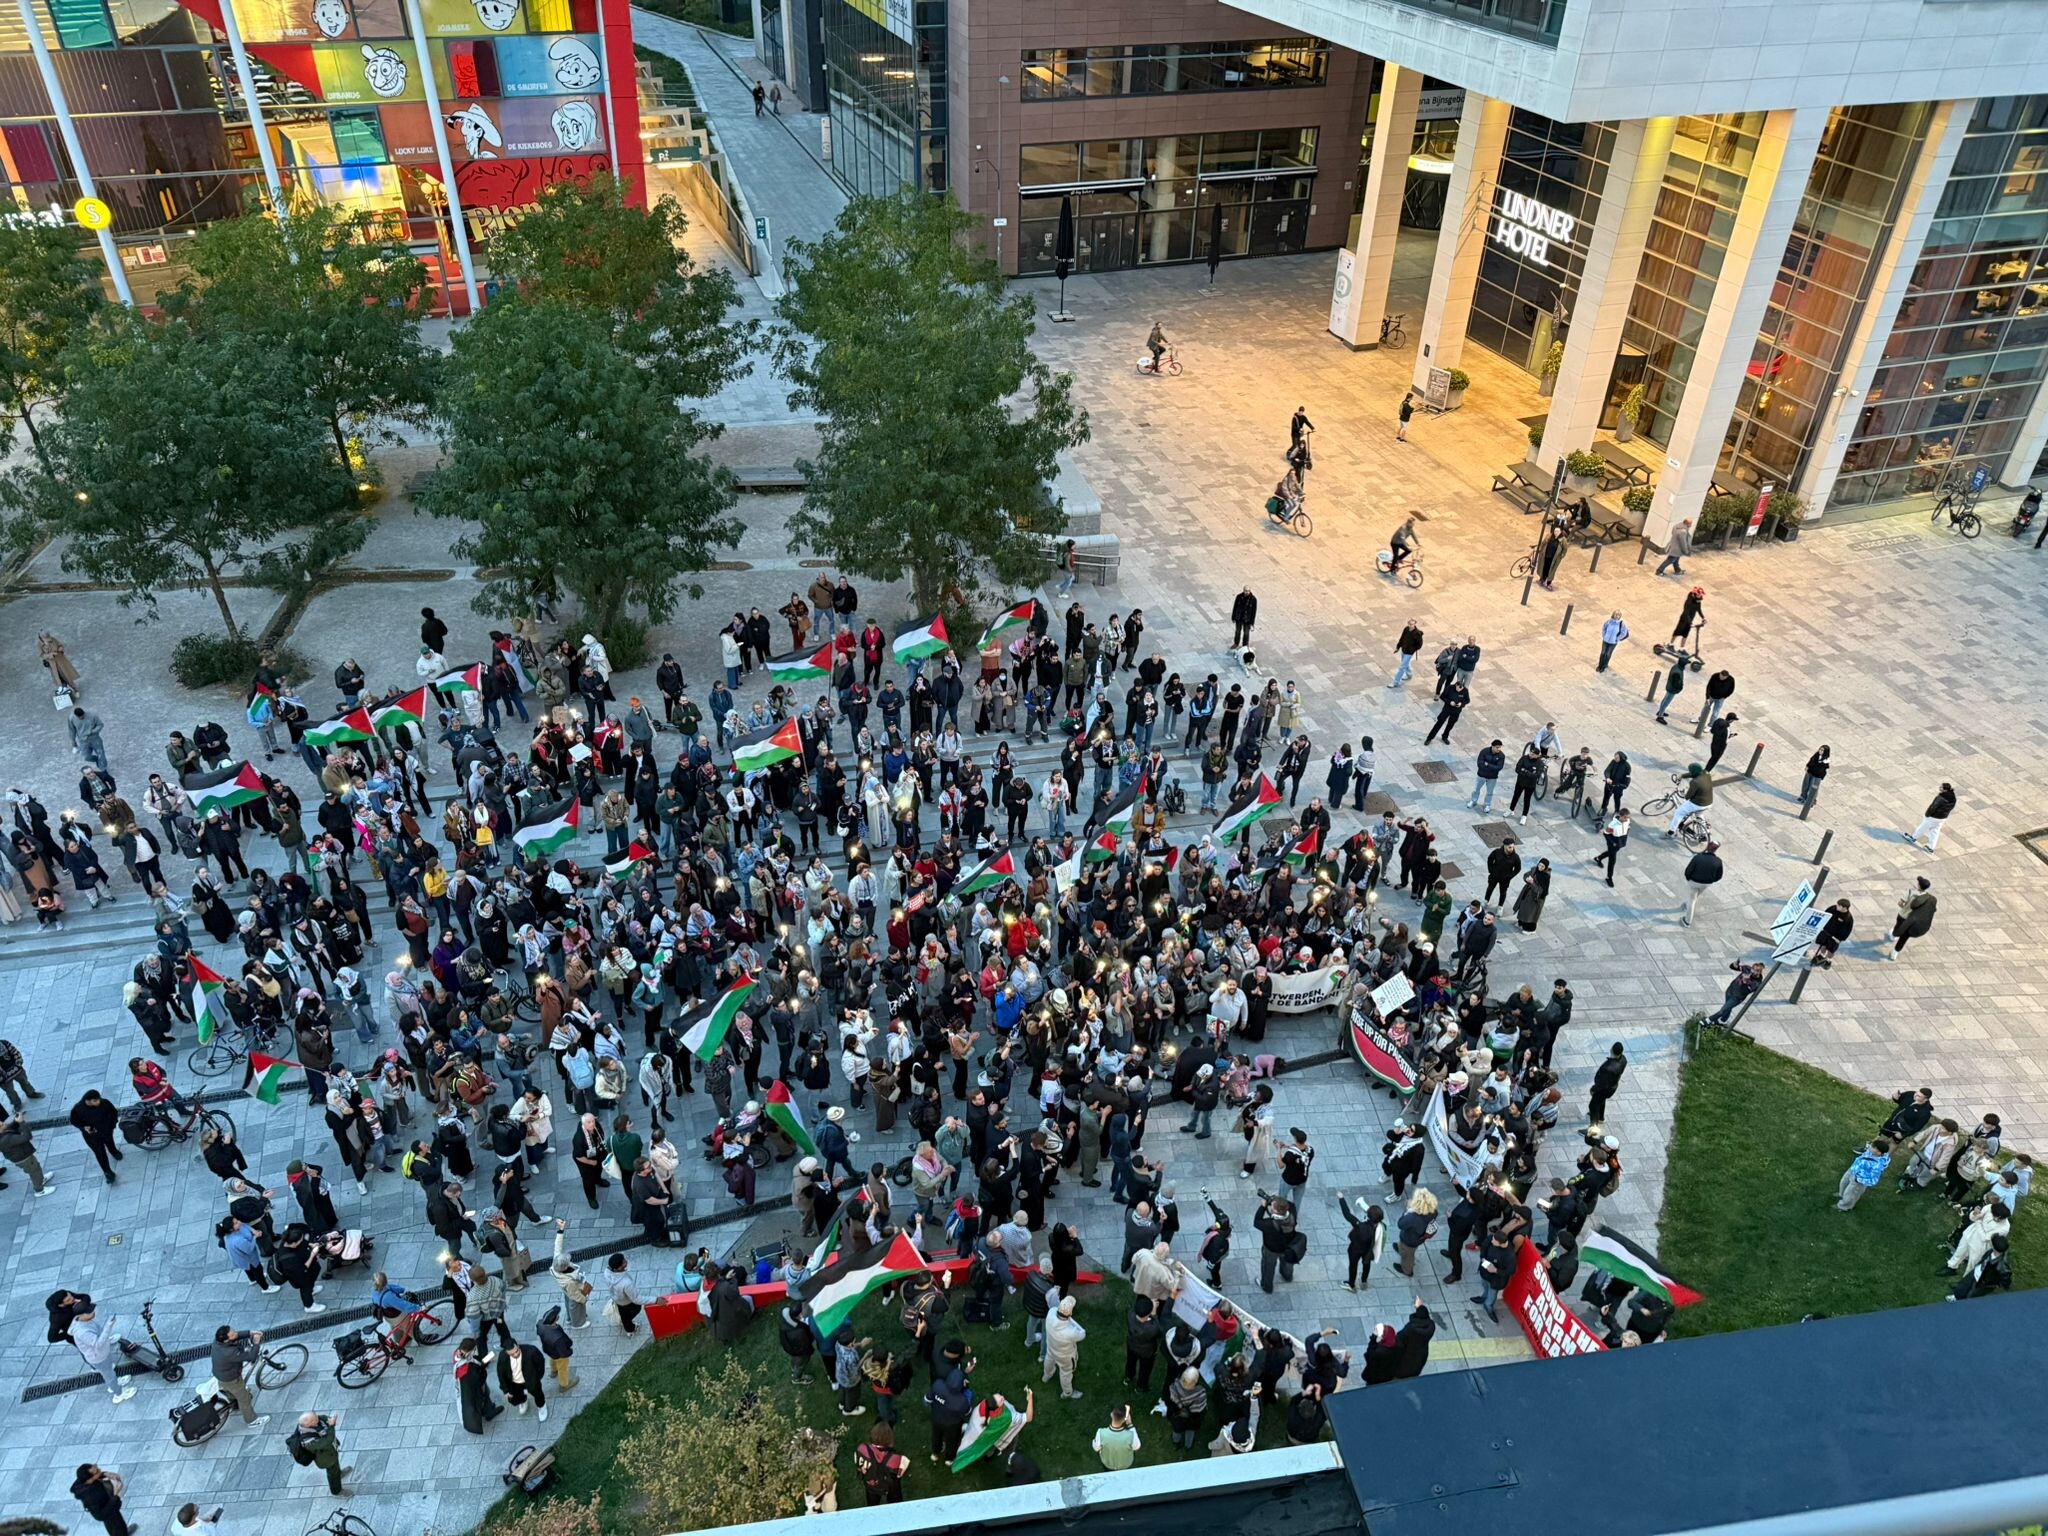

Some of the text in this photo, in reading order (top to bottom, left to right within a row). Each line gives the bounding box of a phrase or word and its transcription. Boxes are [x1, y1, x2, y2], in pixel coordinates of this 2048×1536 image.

[1496, 217, 1550, 267] HOTEL
[1502, 189, 1575, 243] LINDNER
[1350, 1008, 1364, 1031] RISE
[1364, 1022, 1374, 1038] UP
[1373, 1030, 1388, 1052] FOR
[1533, 1261, 1566, 1325] SOUND
[1523, 1293, 1544, 1336] FOR
[1541, 1331, 1567, 1358] GA
[1535, 1292, 1577, 1356] ALARM
